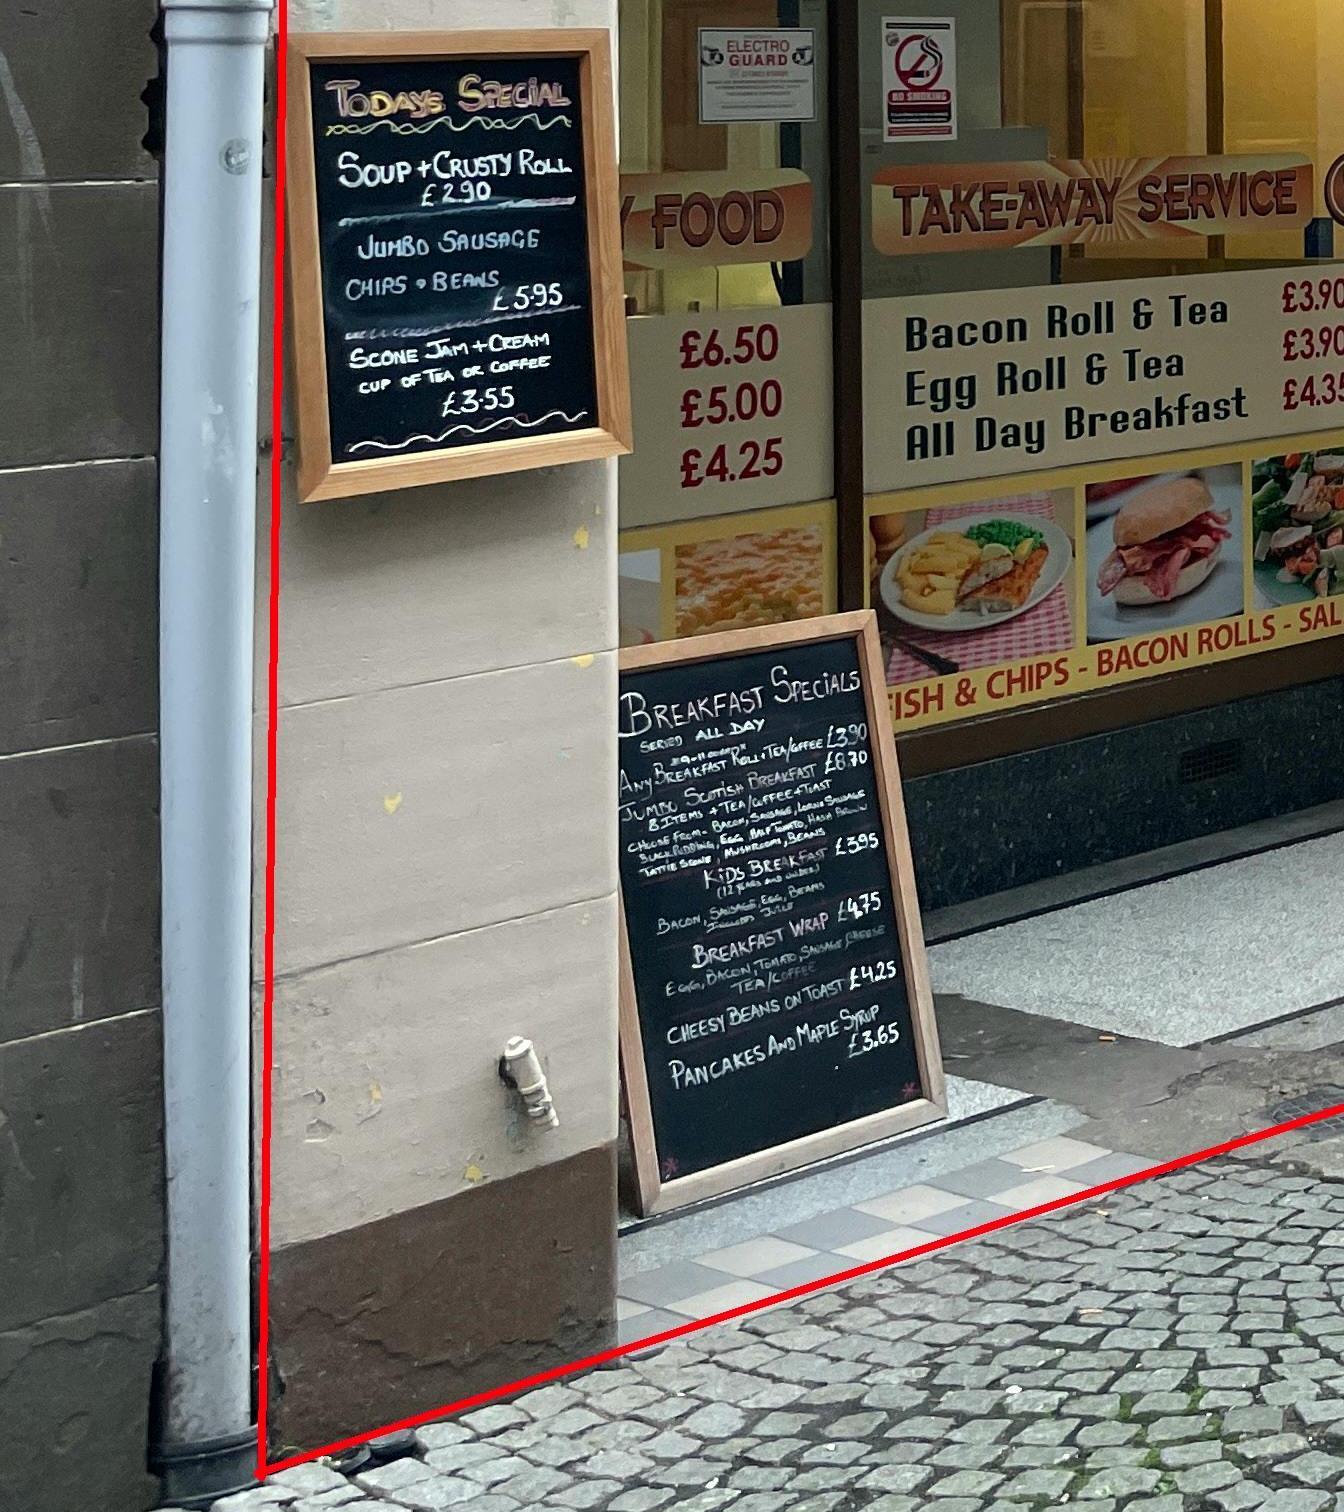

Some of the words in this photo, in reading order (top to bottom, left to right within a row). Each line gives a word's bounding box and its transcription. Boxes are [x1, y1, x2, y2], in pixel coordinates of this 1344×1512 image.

[727, 39, 790, 53] ELECTRO
[729, 54, 788, 66] GUARD
[338, 151, 412, 187] SOUP
[433, 150, 511, 179] CRUSTY
[519, 149, 572, 175] ROLL
[652, 189, 785, 249] FOOD
[892, 175, 1123, 238] TAKE-AWAY
[1137, 170, 1298, 224] SERVICE
[357, 234, 429, 260] JUMBO
[438, 229, 540, 253] SAUSAGE
[345, 277, 406, 301] CHIPS
[433, 270, 499, 291] BEANS
[679, 323, 779, 369] £6.50
[904, 315, 1028, 353] Bacon
[1047, 301, 1115, 339] Roll
[1132, 297, 1154, 331] &
[1168, 294, 1229, 328] Tea
[349, 347, 418, 369] SCONE
[489, 333, 549, 352] CREAM
[359, 379, 392, 394] CUP
[401, 374, 422, 388] OF
[422, 369, 454, 384] TEA
[462, 366, 484, 378] OR
[490, 356, 551, 372] COFFEE
[680, 379, 782, 428] £5.00
[905, 370, 976, 414] Egg
[997, 356, 1066, 397] Roll
[1086, 352, 1107, 386] &
[1123, 348, 1185, 382] Tea
[906, 422, 955, 461] All
[975, 414, 1045, 454] Day
[1065, 386, 1249, 441] Breakfast
[680, 437, 783, 489] £4.25
[890, 683, 944, 722] ISH
[954, 678, 977, 707] &
[986, 657, 1069, 701] CHIPS
[1096, 632, 1190, 676] BACON
[1197, 613, 1276, 656] ROLLS
[618, 686, 764, 738] BREAKFAST
[695, 727, 724, 742] ALL
[729, 719, 765, 735] DAY
[748, 848, 828, 871] BREAKFAST
[691, 928, 785, 970] BREAKFAST
[789, 912, 829, 939] WRAP
[666, 1015, 726, 1045] CHEESY
[726, 999, 780, 1027] BEANS
[784, 990, 803, 1011] ON
[802, 977, 847, 1002] TOAST
[668, 1044, 767, 1091] PANCAKES
[767, 1033, 796, 1057] AND
[796, 1018, 840, 1048] MAPLE
[839, 1004, 881, 1032] SYRUP
